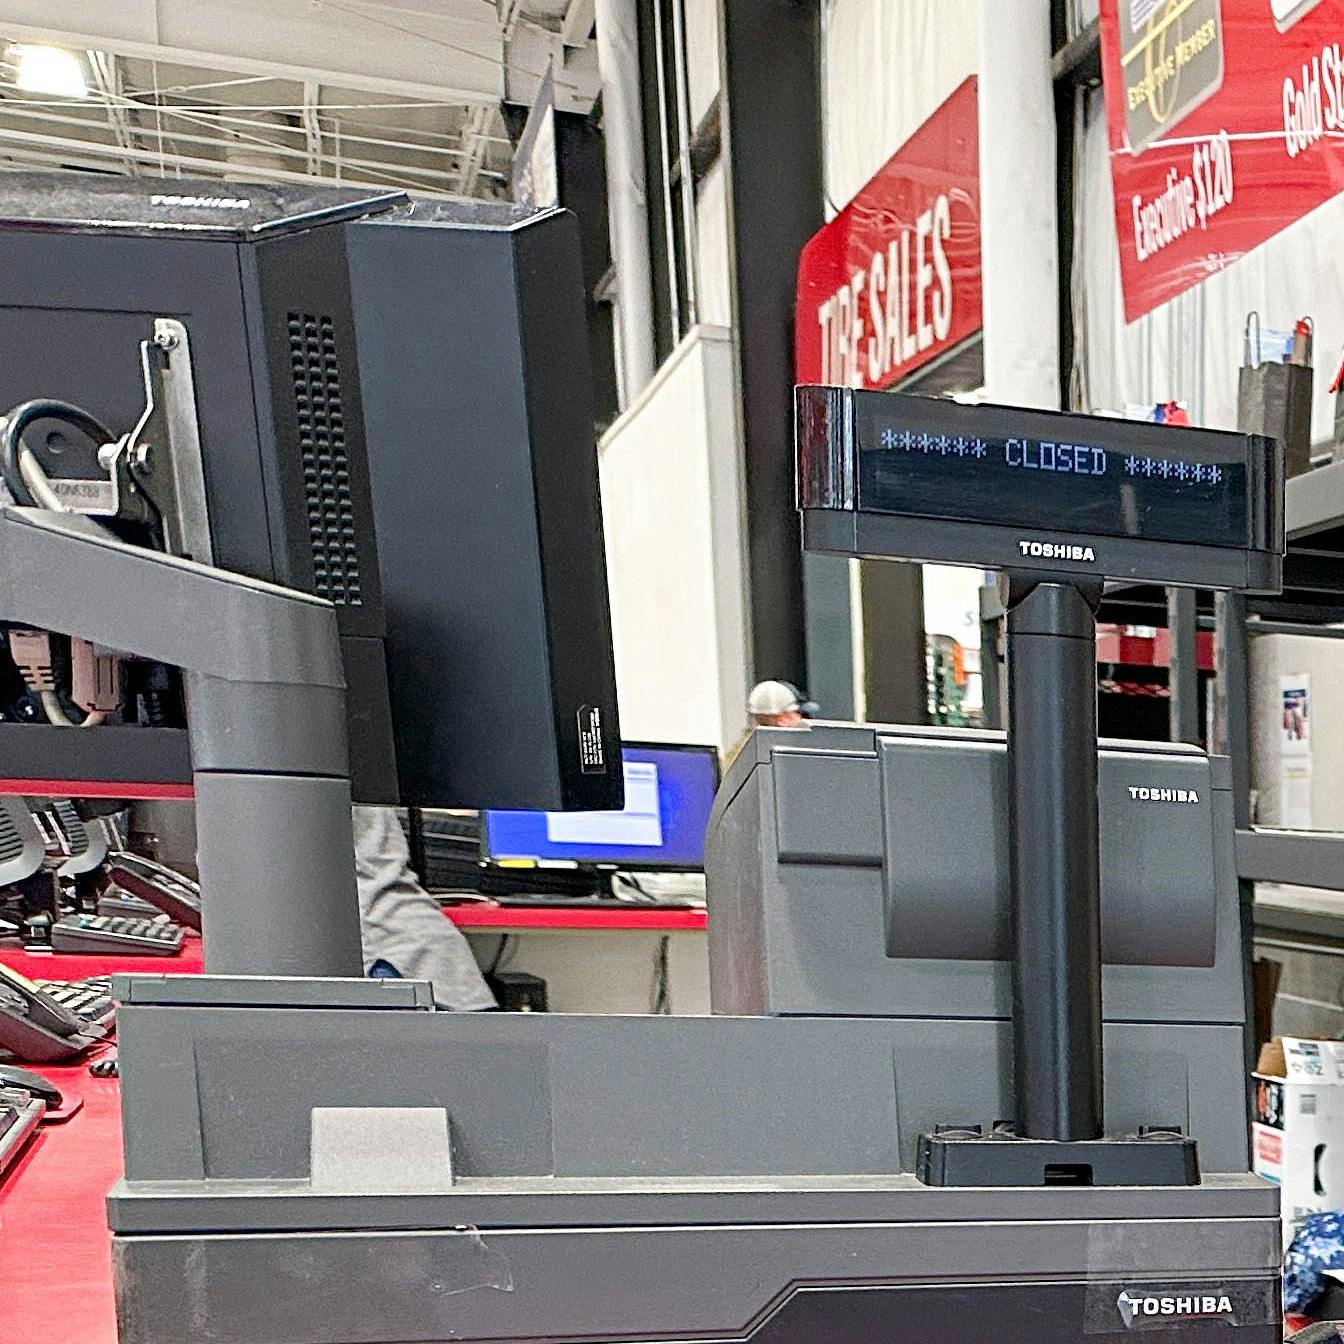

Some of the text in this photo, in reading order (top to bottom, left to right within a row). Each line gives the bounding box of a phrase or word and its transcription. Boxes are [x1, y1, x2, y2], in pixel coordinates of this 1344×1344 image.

[1283, 56, 1323, 157] Gold
[1132, 129, 1234, 261] Executive $120
[818, 195, 952, 390] TIRE SALES
[1006, 438, 1107, 476] CLOSED
[1019, 540, 1096, 562] TOSHIBA
[1128, 786, 1199, 804] TOSHIBA
[1127, 1295, 1232, 1315] TOSHIBA
